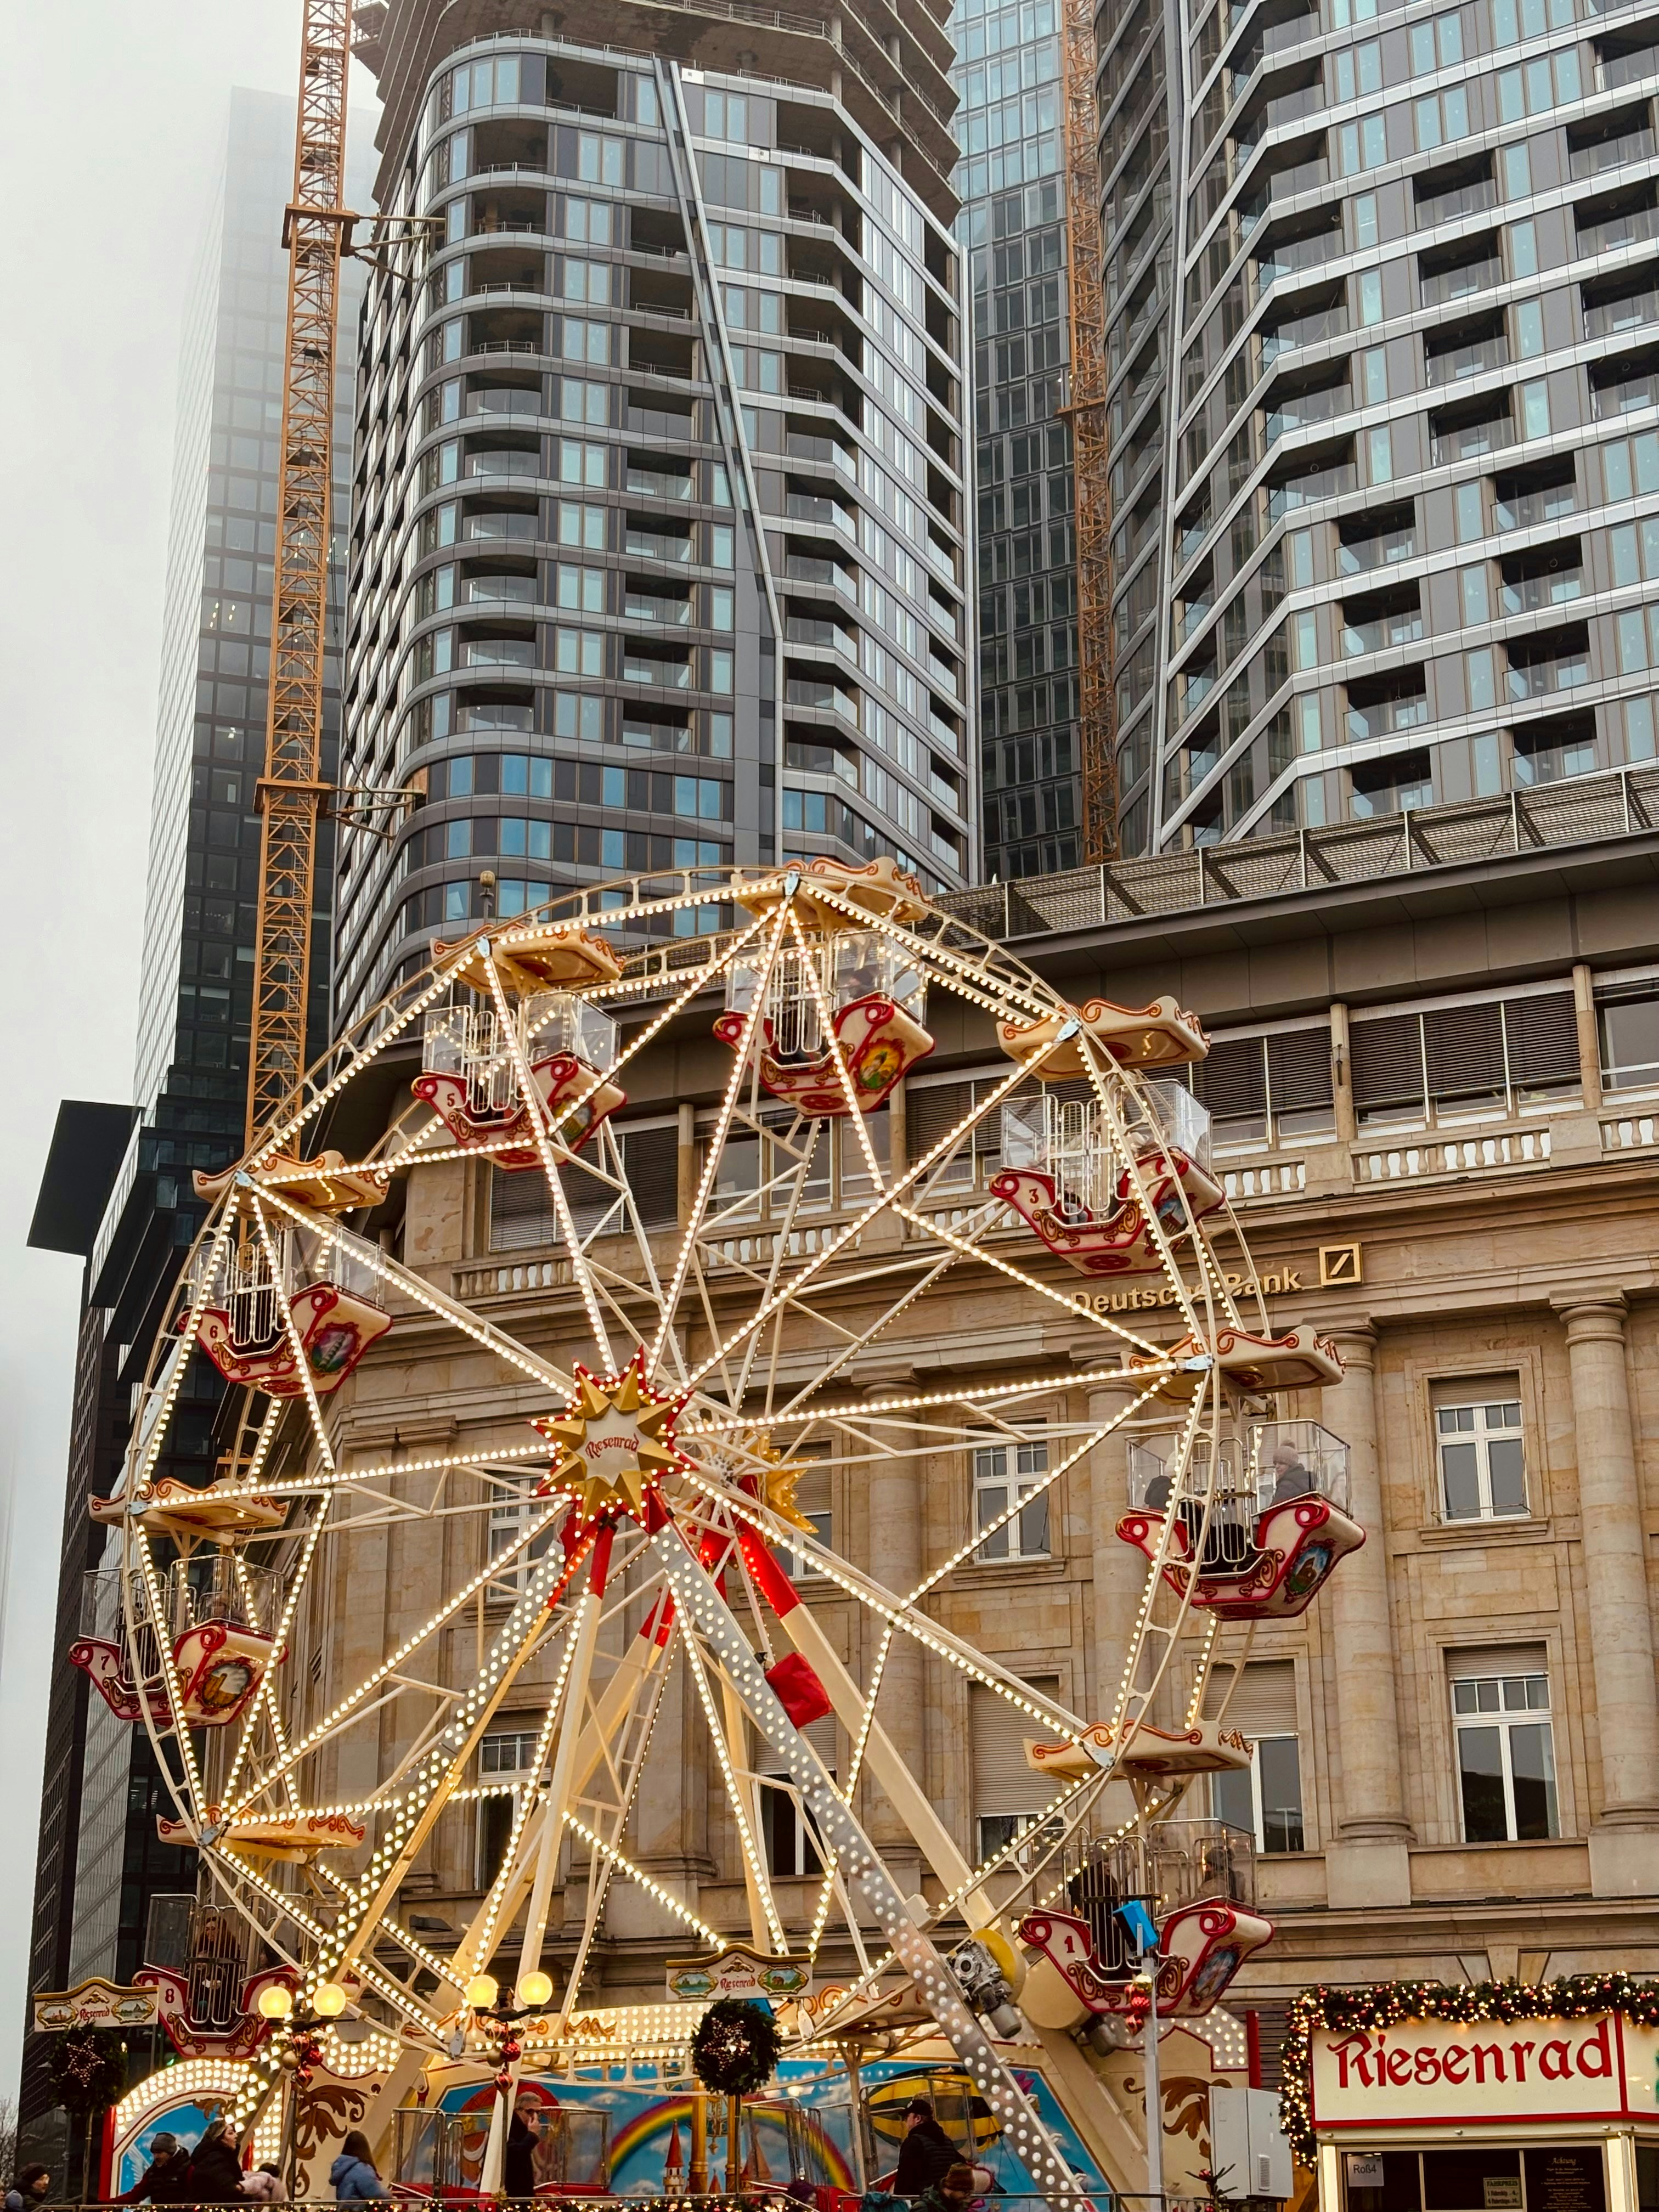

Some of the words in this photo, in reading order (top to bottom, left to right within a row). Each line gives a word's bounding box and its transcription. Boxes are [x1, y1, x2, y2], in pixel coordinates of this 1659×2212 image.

[447, 1092, 455, 1107] 5
[1029, 1188, 1039, 1204] 3
[210, 1325, 218, 1339] 6
[585, 1433, 640, 1459] Riesenrad
[100, 1655, 110, 1671] 7
[1064, 1936, 1075, 1953] 1
[165, 1988, 174, 2004] 8
[1327, 2018, 1612, 2089] Riesenrad
